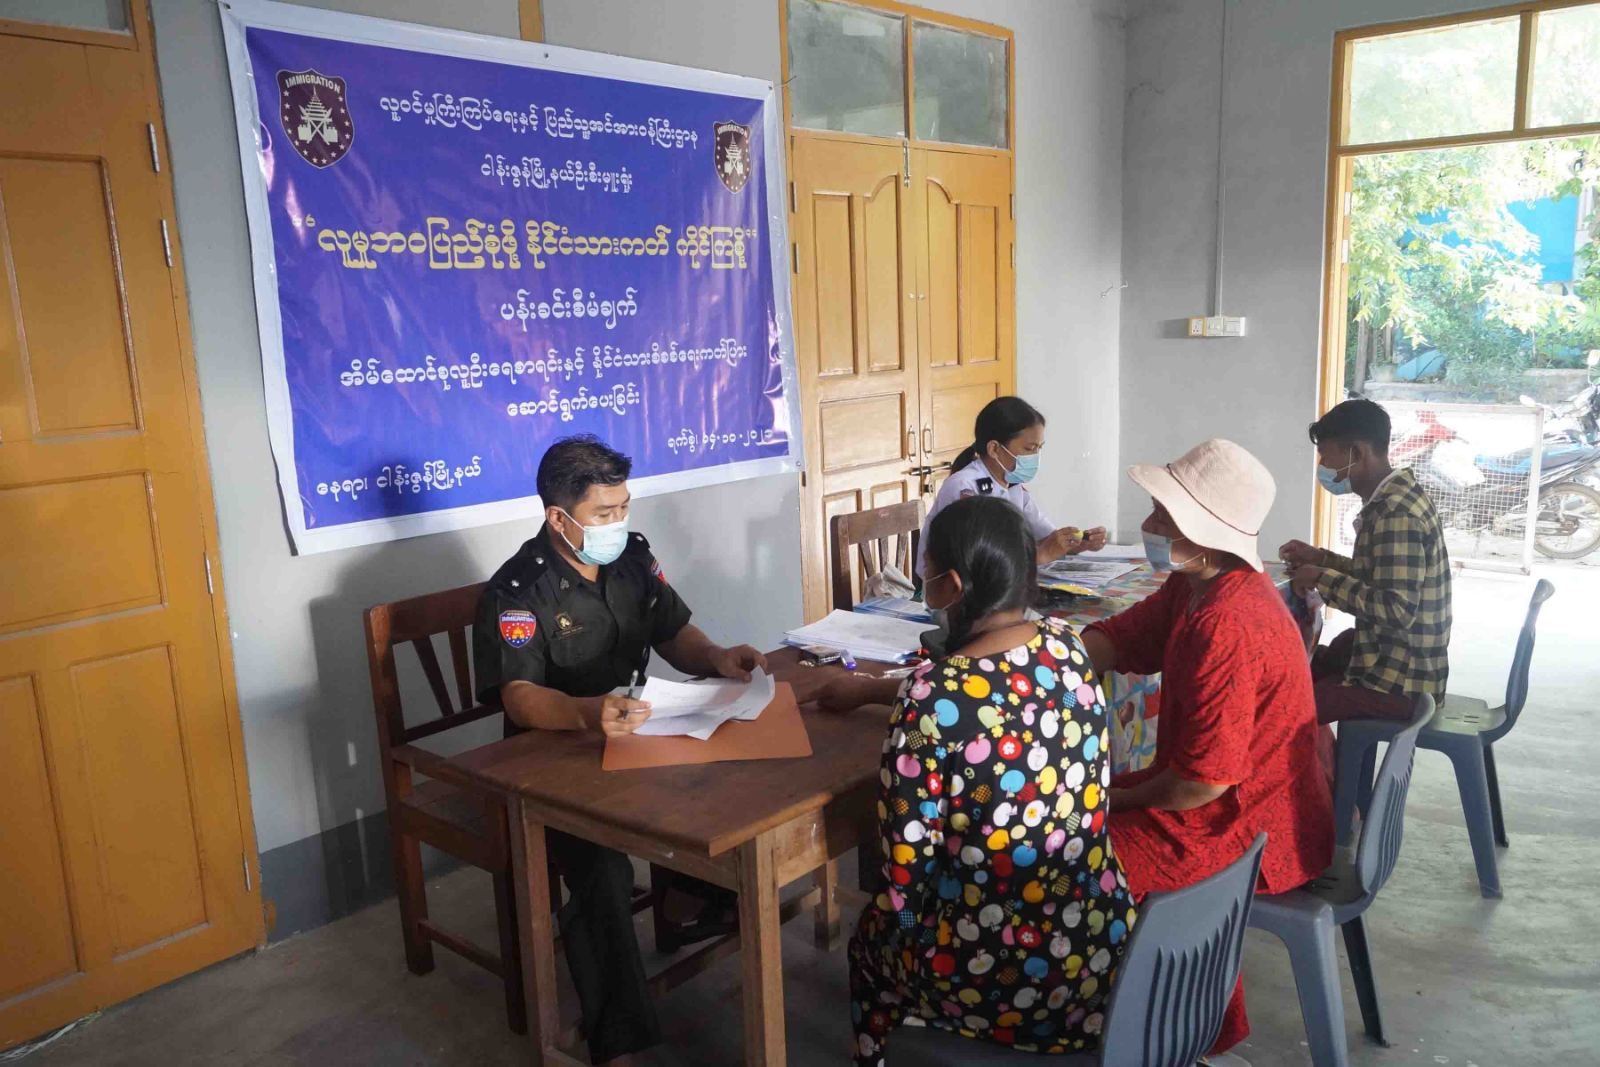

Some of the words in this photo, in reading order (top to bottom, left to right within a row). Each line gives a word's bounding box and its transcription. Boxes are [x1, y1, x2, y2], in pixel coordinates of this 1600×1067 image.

[285, 74, 341, 94] IMMIGRATION
[525, 219, 672, 269] နိုင်ငံသားကတ်
[500, 286, 639, 333] ပန်းခင်းစီမံချက်
[507, 382, 641, 423] ဆောင်ရွက်ပေးခြင်း
